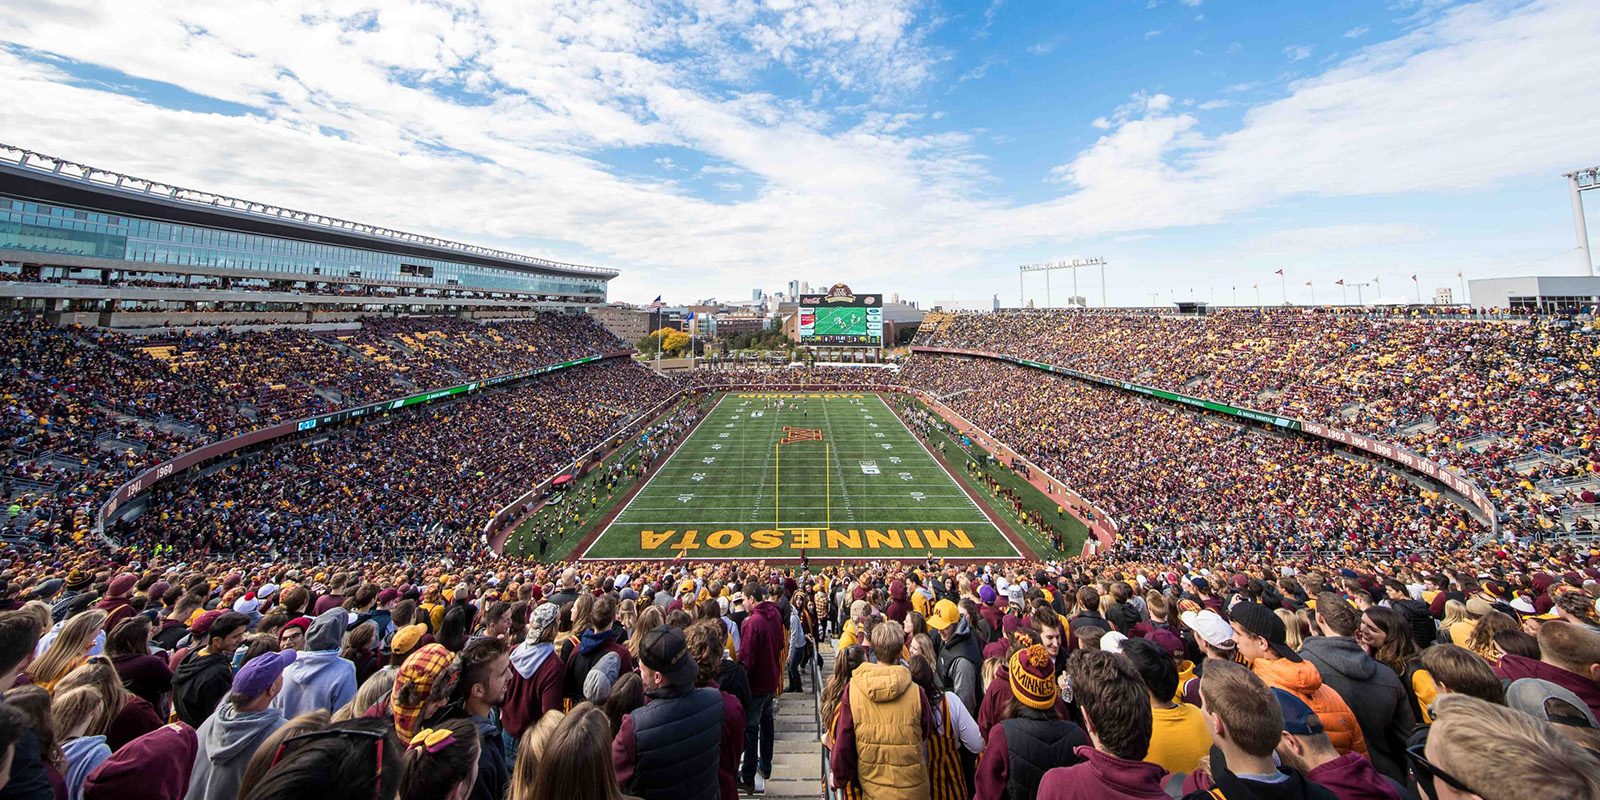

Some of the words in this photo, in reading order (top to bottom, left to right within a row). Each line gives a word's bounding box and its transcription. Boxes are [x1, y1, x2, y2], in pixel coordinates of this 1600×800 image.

[1304, 424, 1322, 434] 1900
[1327, 430, 1346, 441] 1903
[1351, 436, 1368, 448] 1904
[1374, 443, 1392, 456] 1906
[1417, 460, 1434, 474] 1910
[1439, 469, 1452, 485] 1911
[127, 480, 142, 497] 1941
[156, 464, 173, 479] 1960
[640, 529, 976, 550] MINNESOTA
